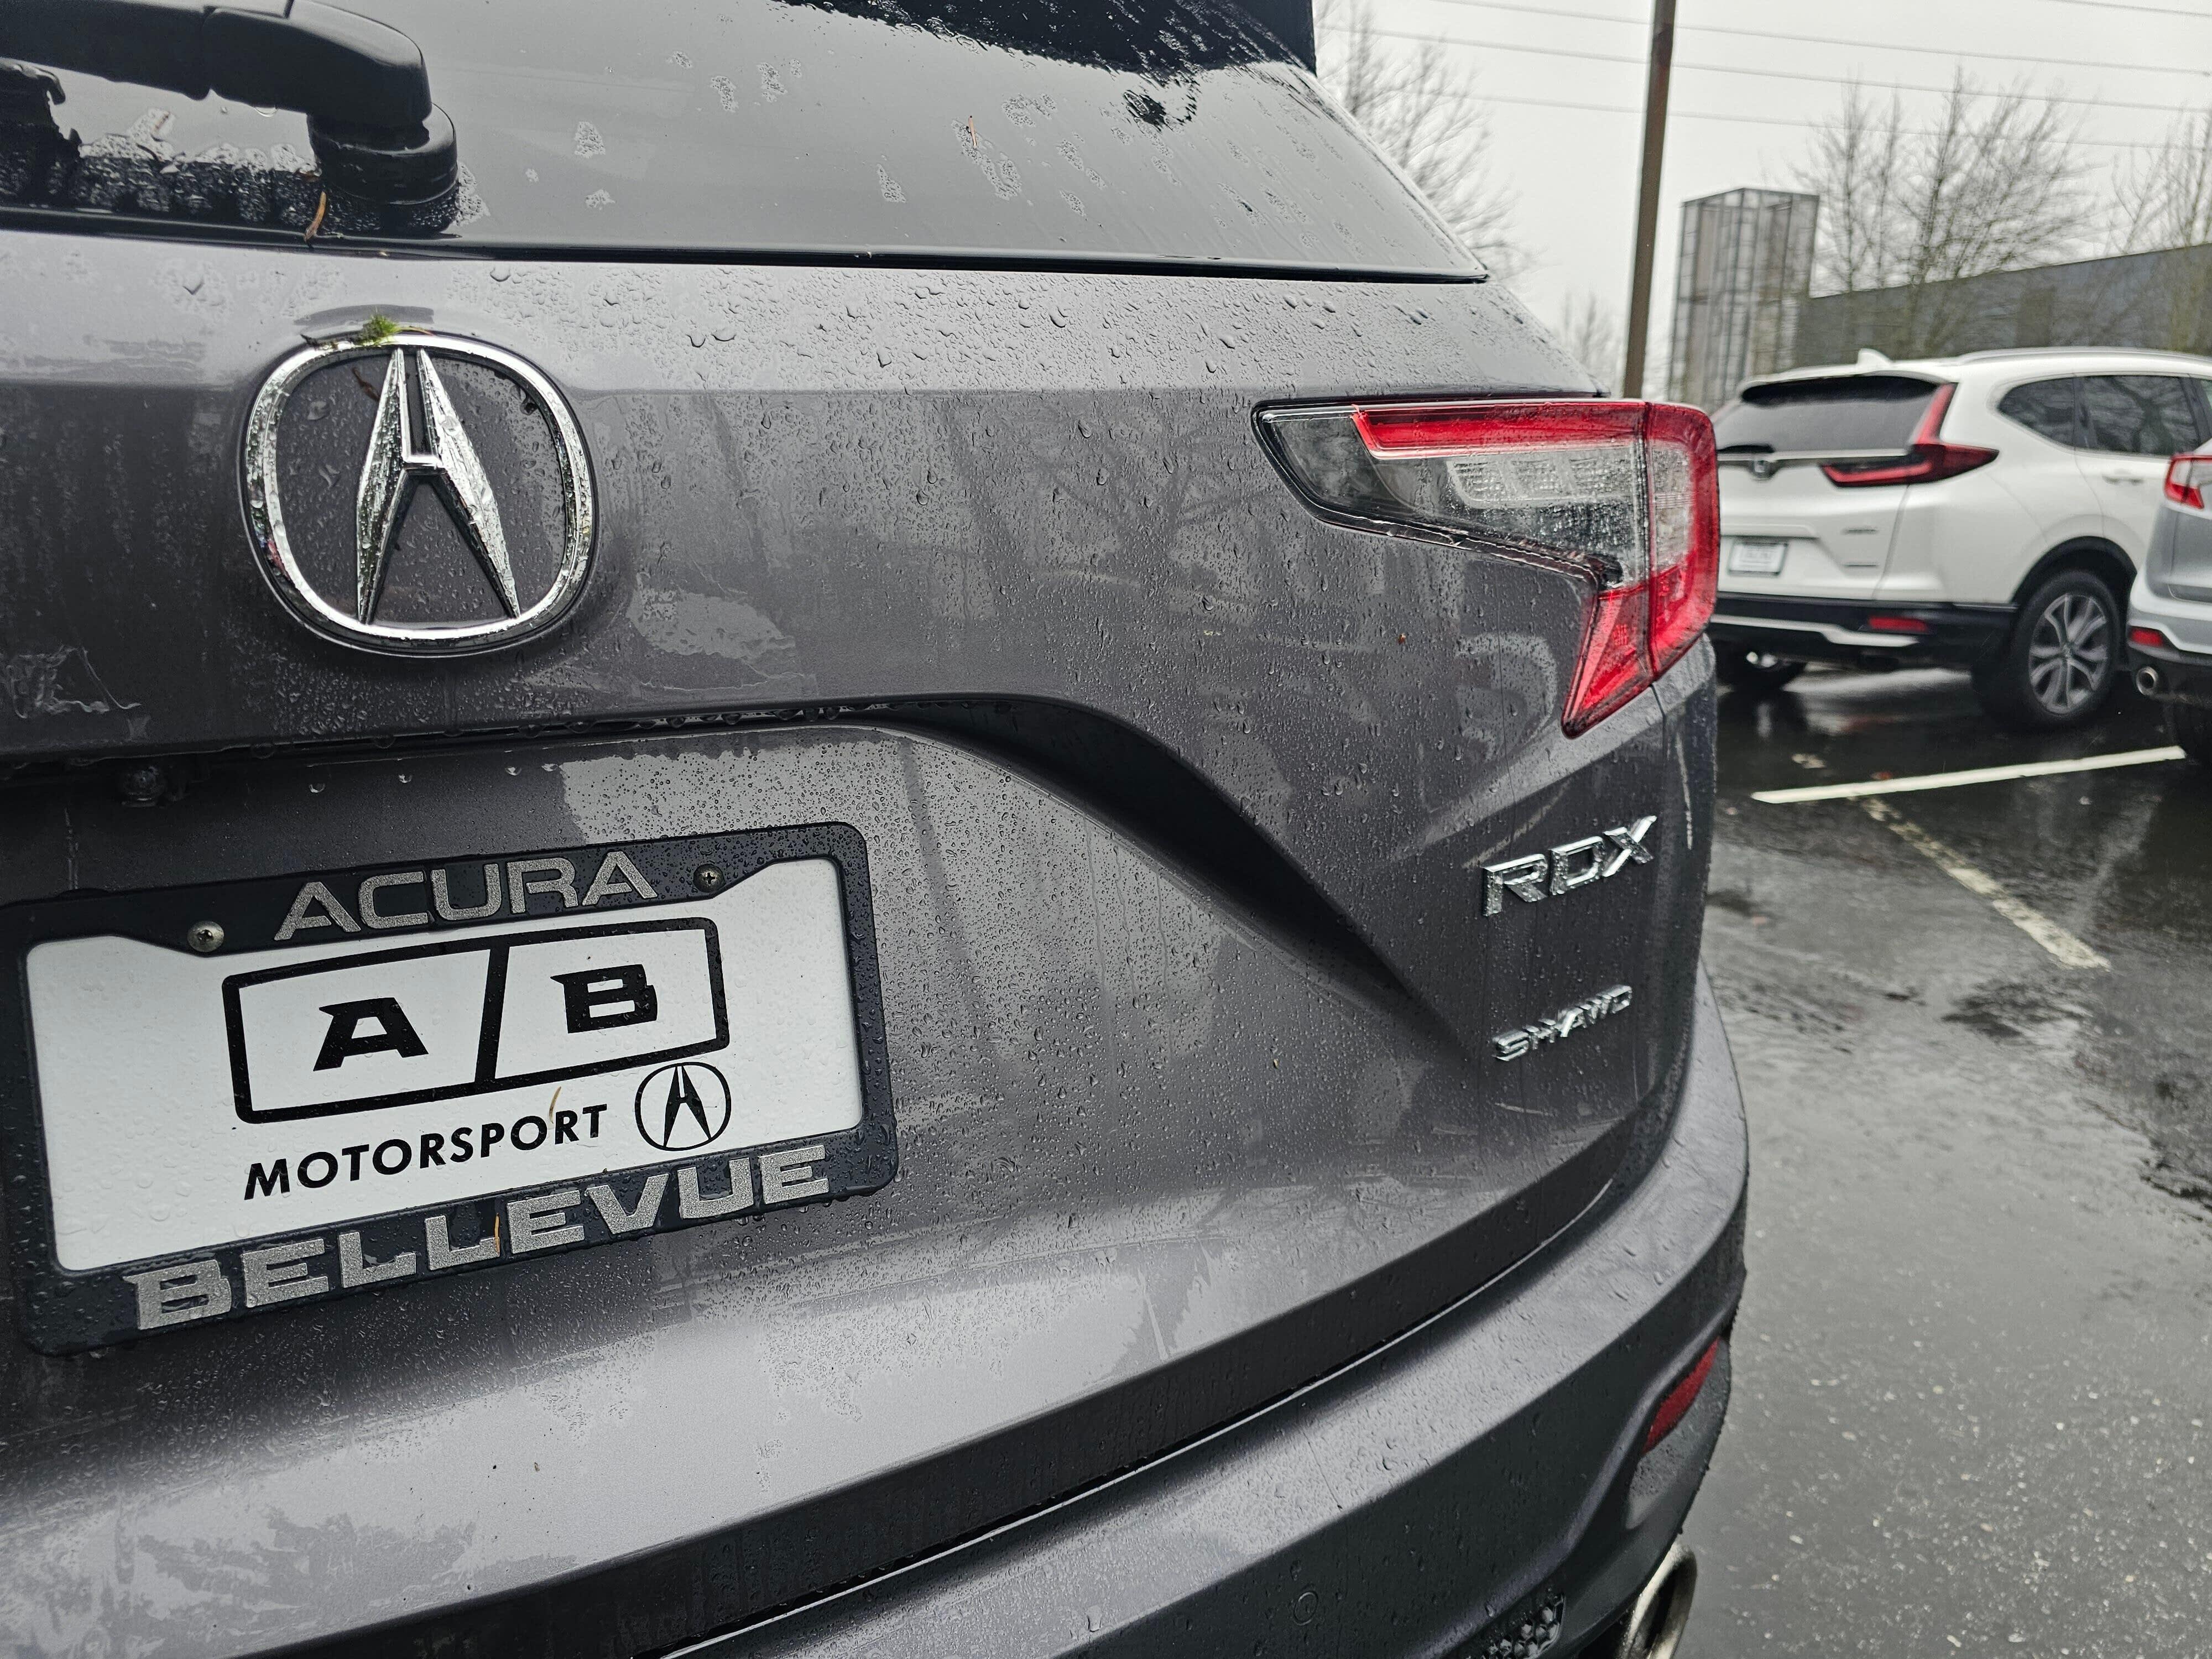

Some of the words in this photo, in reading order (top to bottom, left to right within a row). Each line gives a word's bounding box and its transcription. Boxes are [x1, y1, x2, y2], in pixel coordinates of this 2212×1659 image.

[276, 851, 658, 941] ACURA
[1484, 816, 1657, 916] RDX
[244, 1104, 608, 1201] MOTORSPORT
[123, 1146, 830, 1330] BELLEVUE
